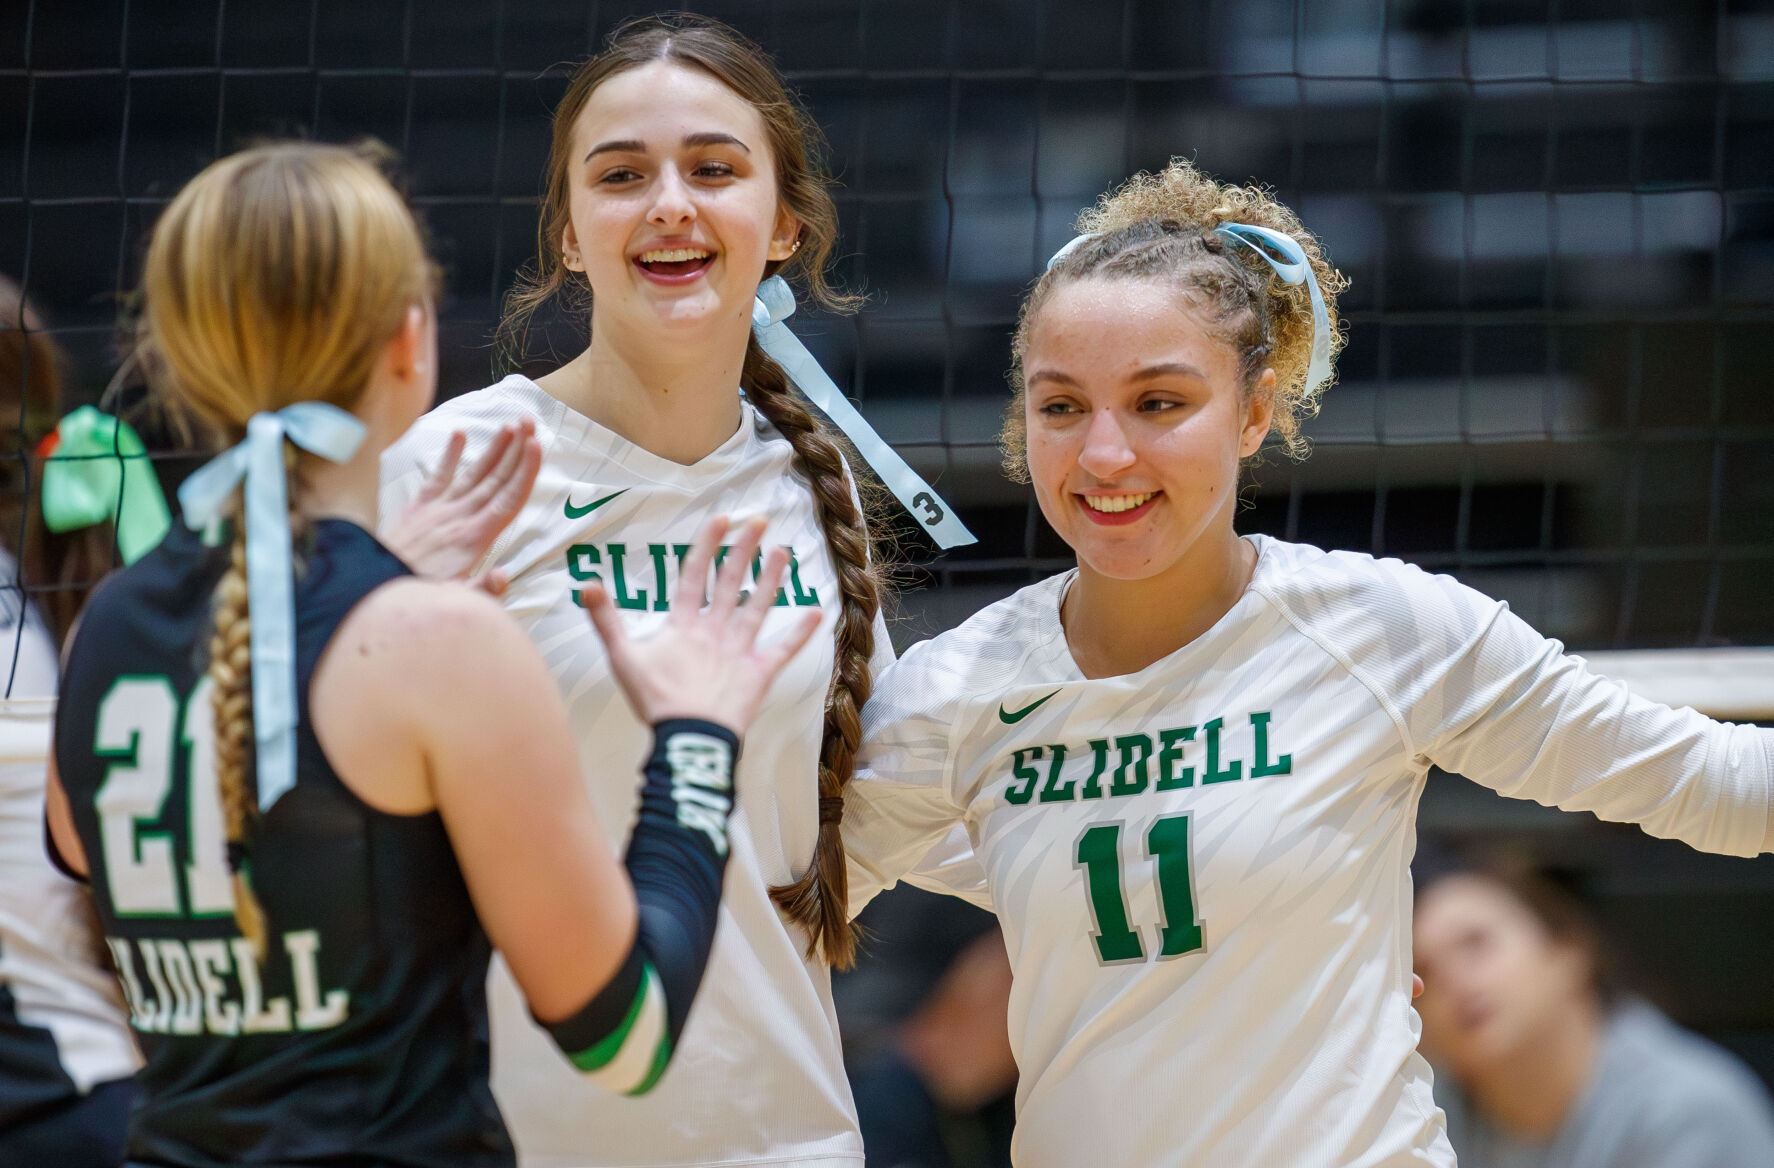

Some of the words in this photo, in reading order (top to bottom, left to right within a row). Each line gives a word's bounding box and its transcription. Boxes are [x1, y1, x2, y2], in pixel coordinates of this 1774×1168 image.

[912, 491, 944, 526] 3
[566, 542, 822, 612] SLIL
[93, 673, 254, 920] 21
[1003, 709, 1294, 807] SLIDELL
[1072, 810, 1208, 968] 11
[105, 928, 350, 1036] LIDELL
